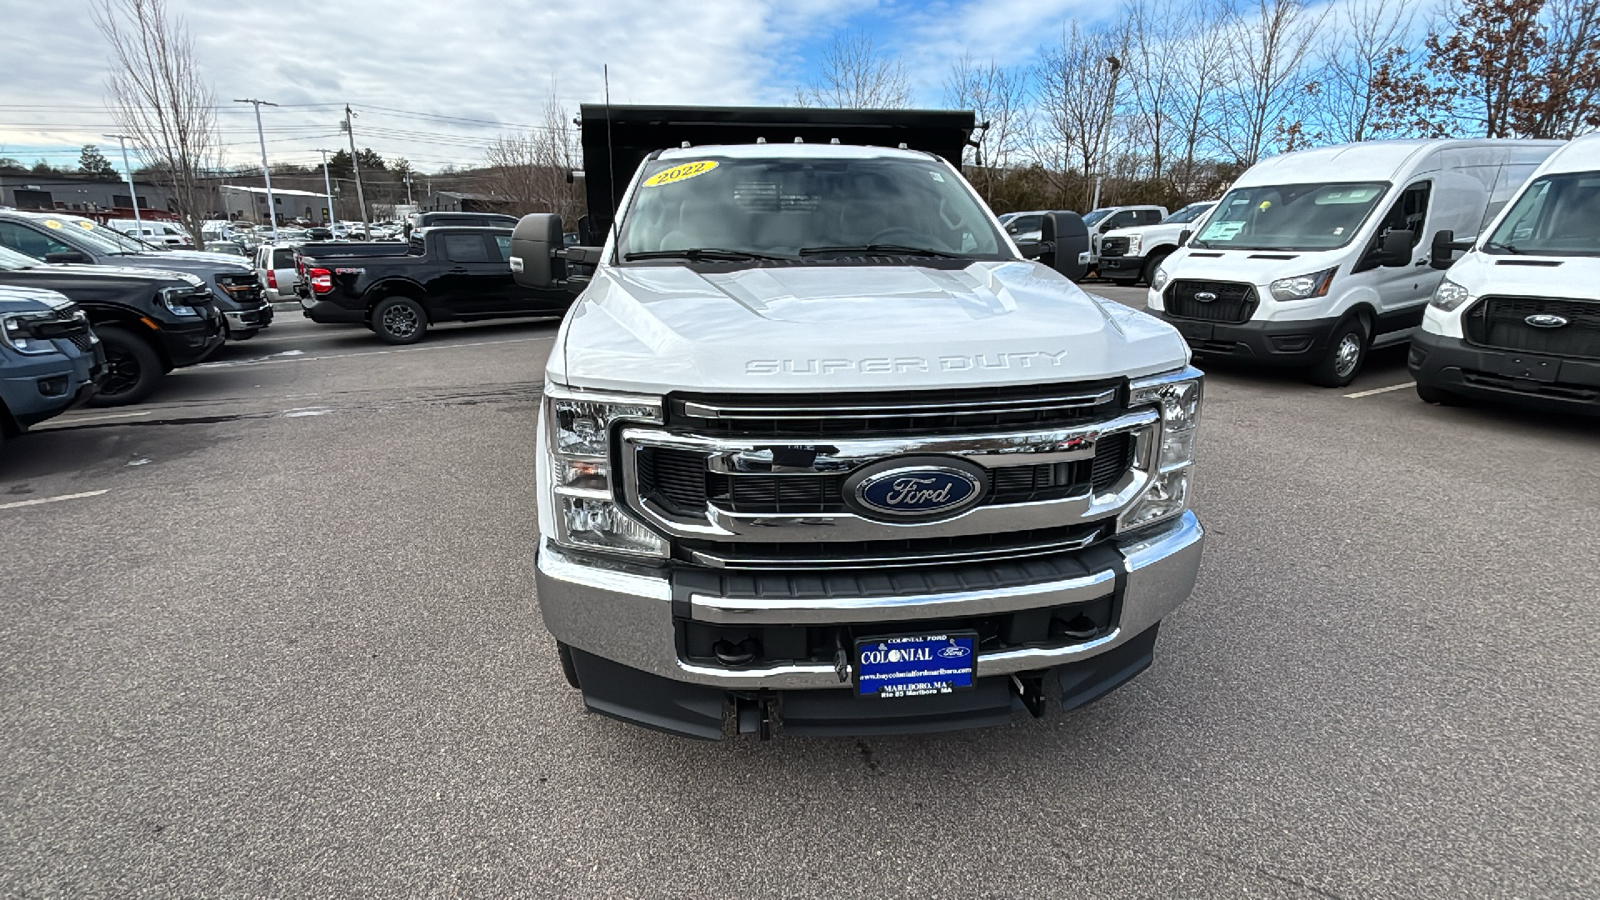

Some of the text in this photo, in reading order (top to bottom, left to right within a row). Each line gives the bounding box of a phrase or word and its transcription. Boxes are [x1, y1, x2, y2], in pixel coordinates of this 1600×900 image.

[657, 162, 705, 183] 2022
[745, 350, 1067, 376] SUPER DUTY
[886, 477, 952, 505] Ford
[927, 634, 947, 642] FORD
[861, 647, 933, 665] COLONIAL
